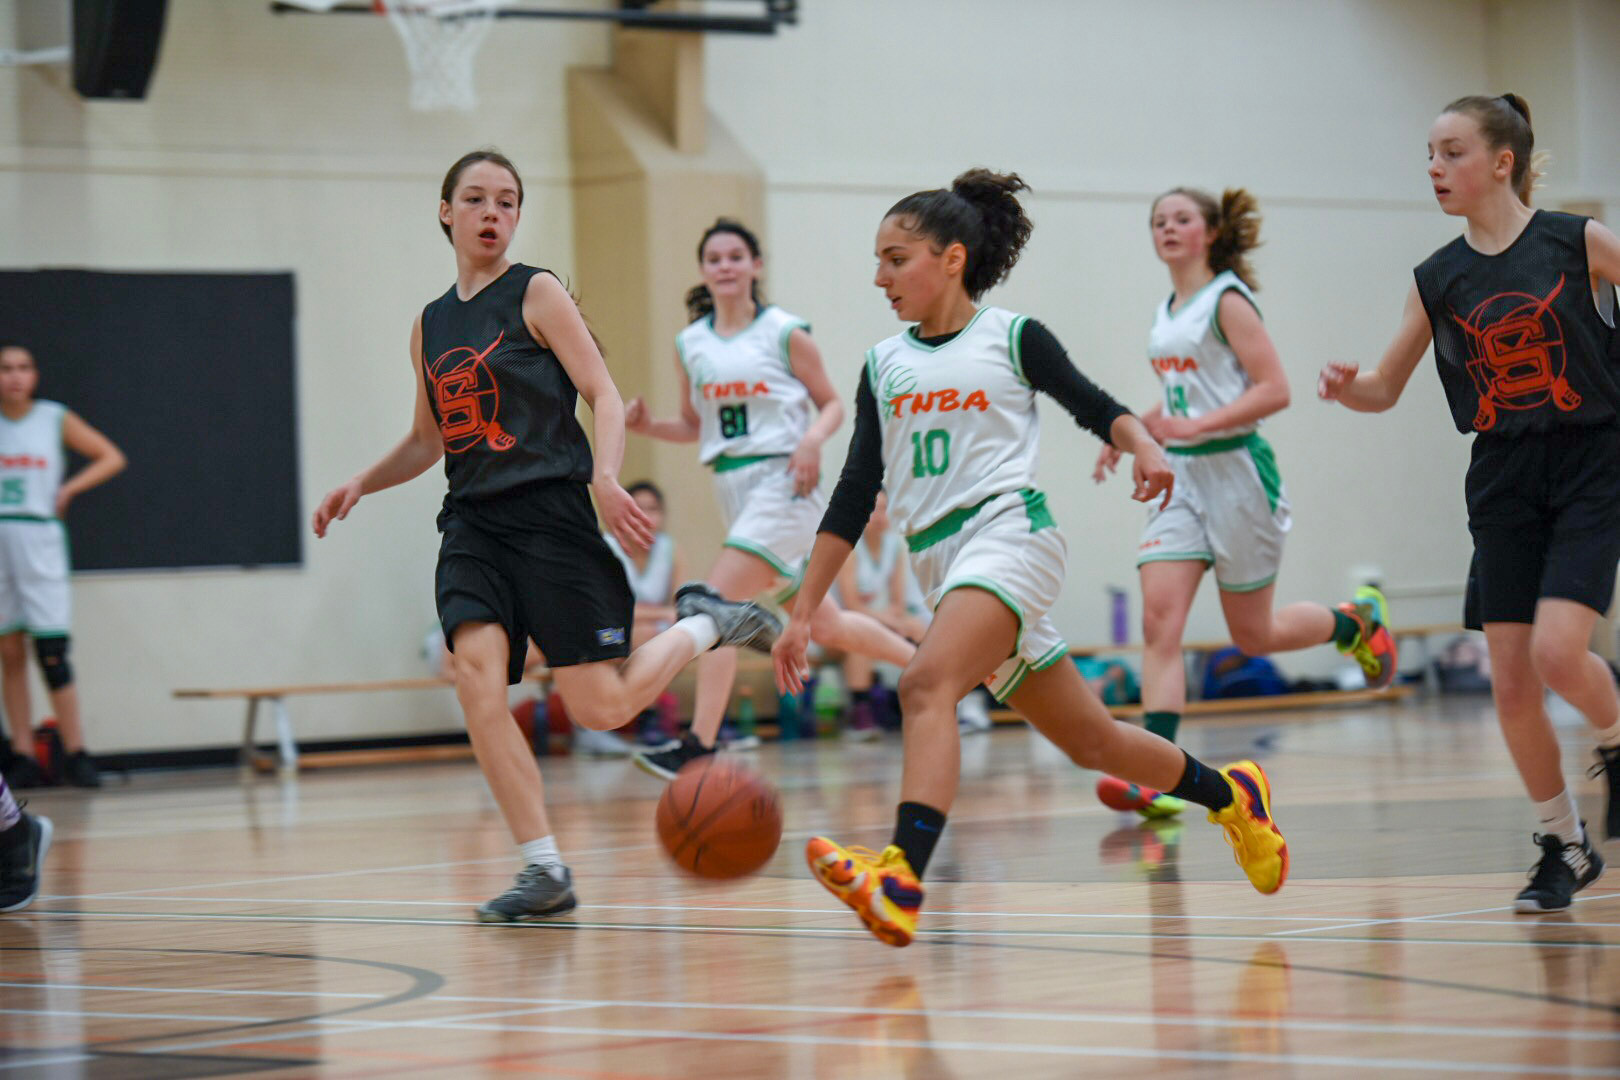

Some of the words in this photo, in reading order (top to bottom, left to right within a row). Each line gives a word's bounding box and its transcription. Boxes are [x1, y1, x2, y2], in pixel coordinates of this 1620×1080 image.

[703, 381, 770, 400] TNBA
[891, 388, 990, 418] TNBA
[911, 429, 951, 479] 10
